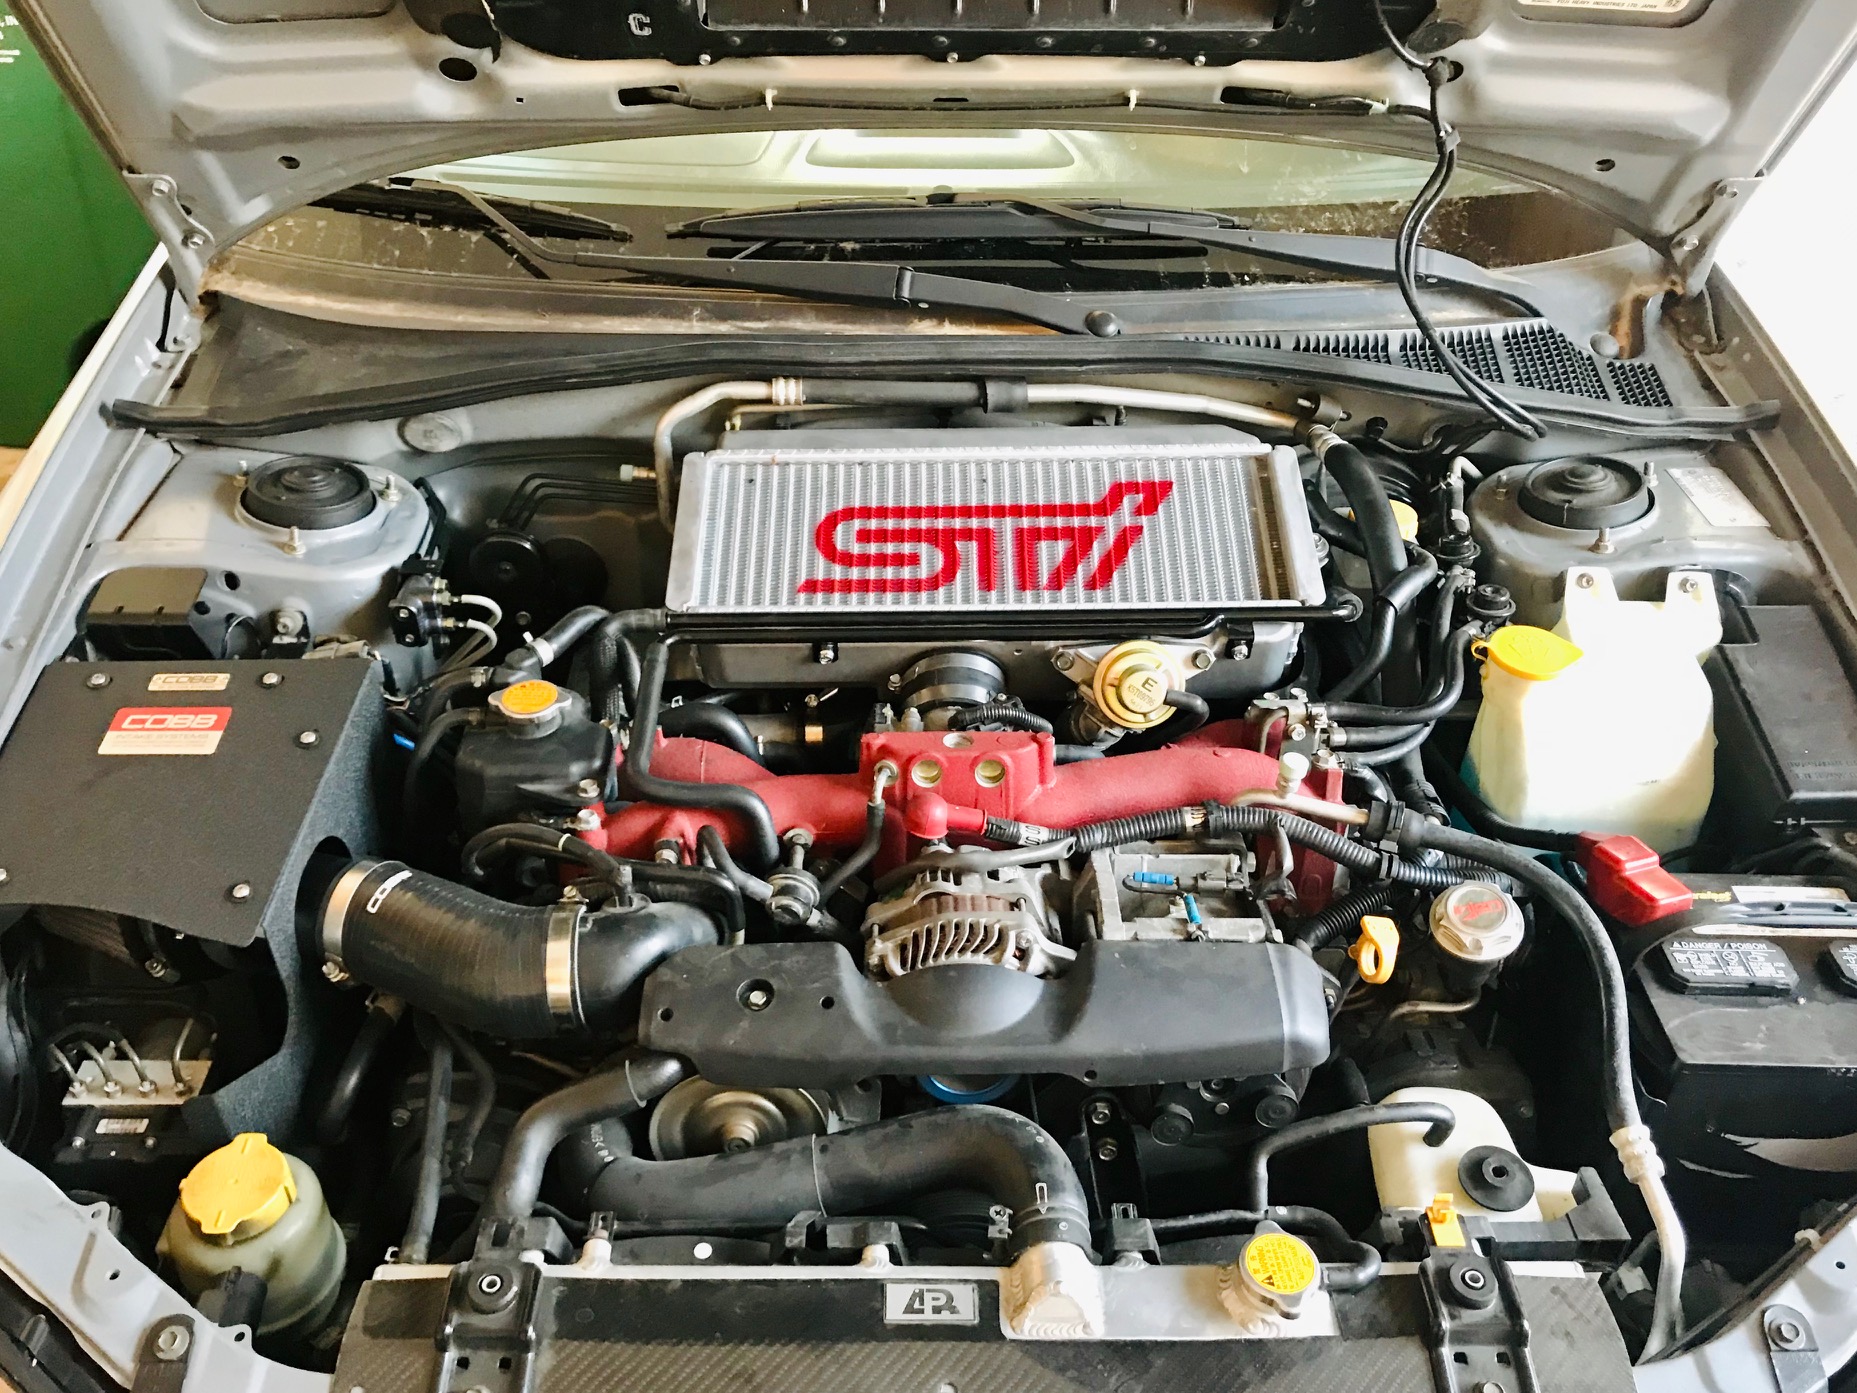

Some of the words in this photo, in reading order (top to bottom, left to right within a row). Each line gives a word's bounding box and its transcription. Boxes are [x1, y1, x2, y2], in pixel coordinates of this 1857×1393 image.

[162, 675, 218, 684] COBB
[1141, 677, 1158, 692] E
[121, 714, 218, 729] COBB
[366, 869, 413, 914] CO
[1681, 942, 1720, 950] DANGER
